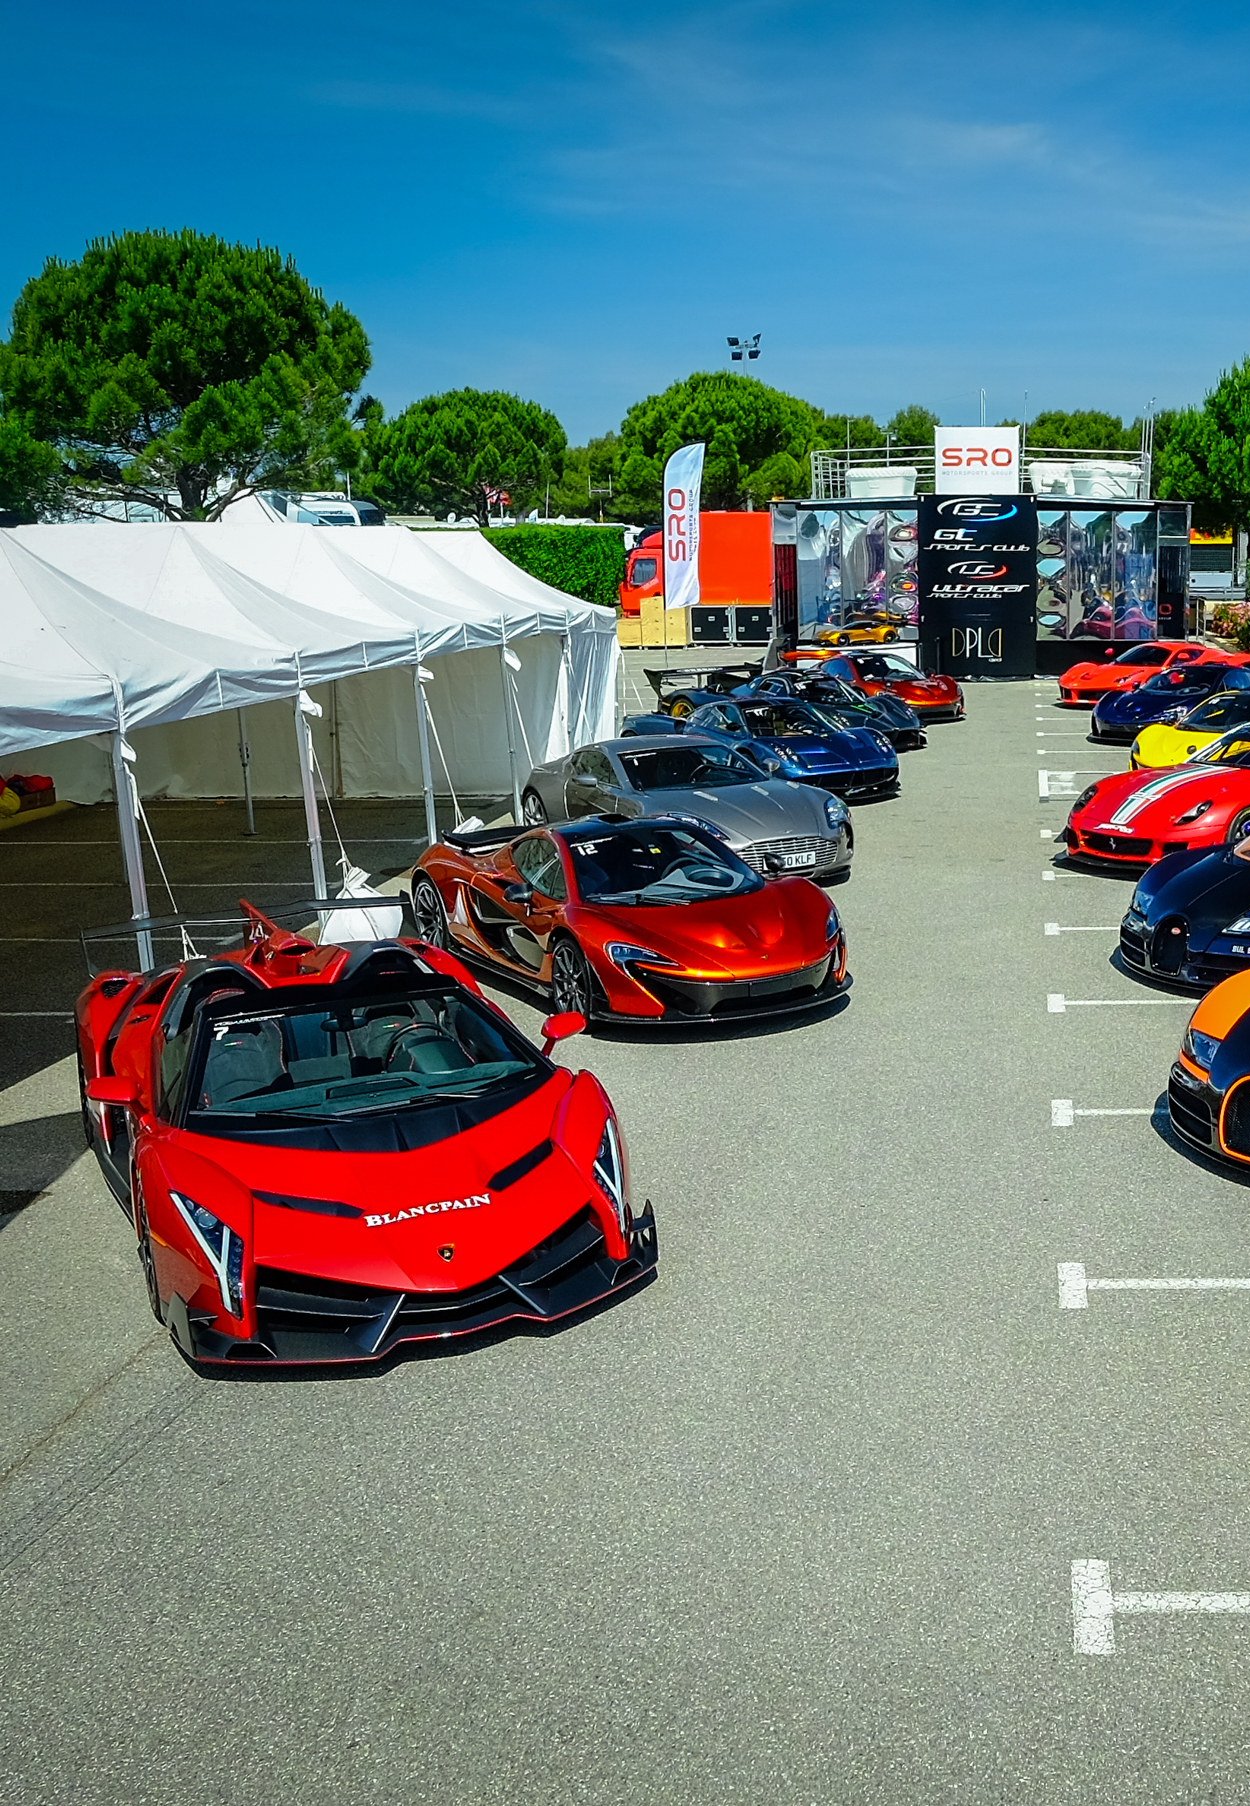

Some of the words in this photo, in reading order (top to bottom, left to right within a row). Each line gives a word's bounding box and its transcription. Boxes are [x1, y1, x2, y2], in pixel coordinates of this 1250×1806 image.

[941, 447, 1013, 467] SRO
[667, 488, 686, 562] SRO
[577, 843, 599, 857] 12
[795, 853, 813, 866] KLF
[213, 1026, 229, 1041] 7
[363, 1193, 491, 1227] BLANCPAIN
